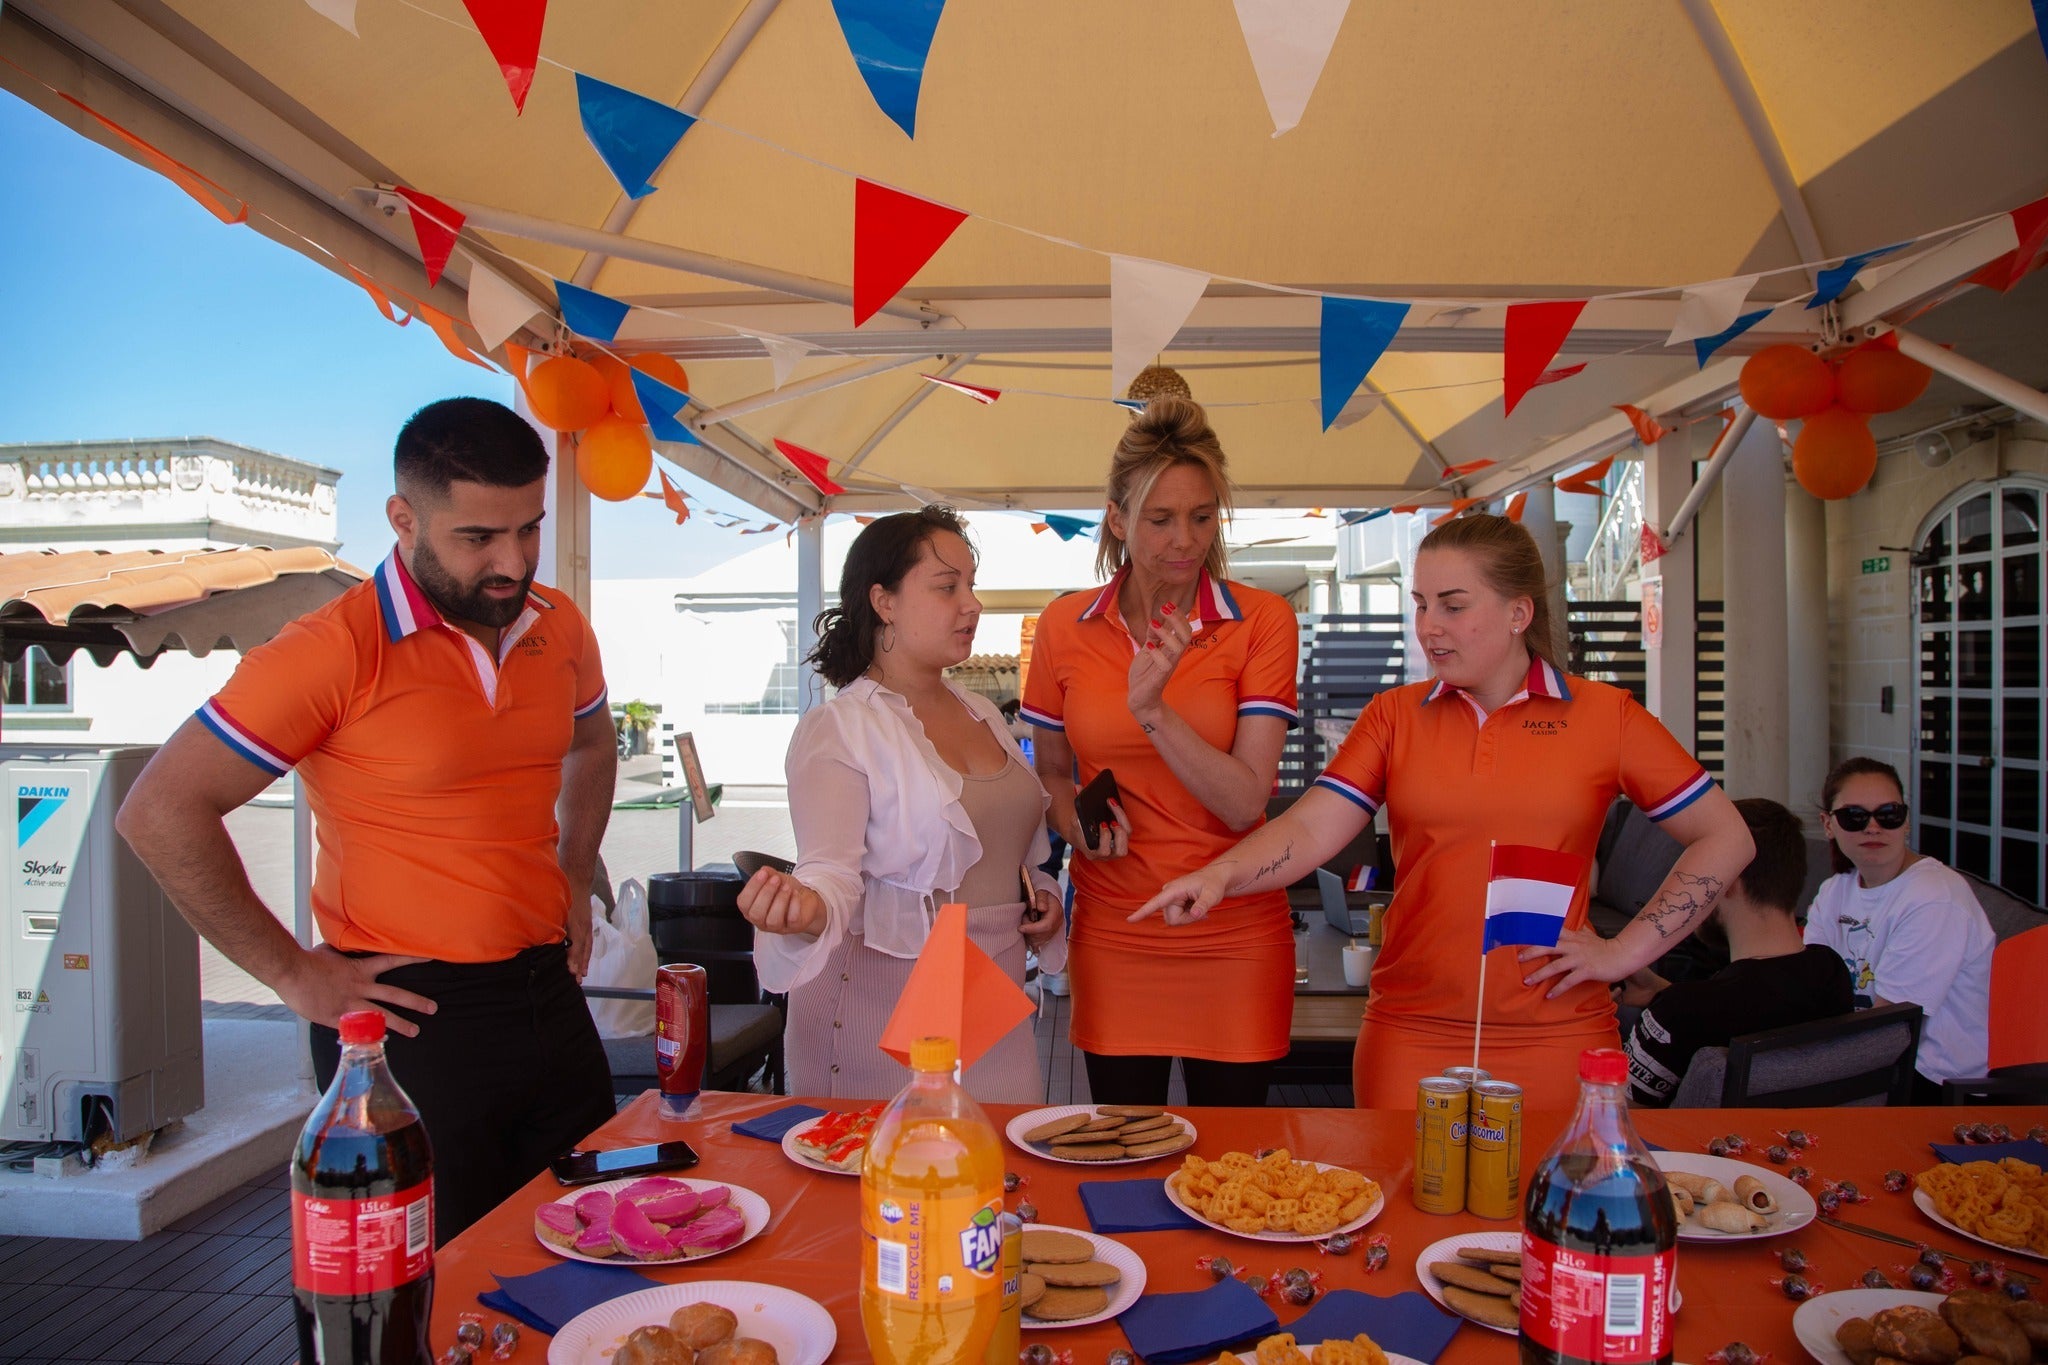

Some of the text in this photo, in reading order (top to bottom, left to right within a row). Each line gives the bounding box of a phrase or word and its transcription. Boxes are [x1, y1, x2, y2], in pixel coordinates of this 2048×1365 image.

[1522, 720, 1568, 729] JACK'S
[18, 786, 70, 798] DAIKIN
[22, 860, 67, 877] SkyAir
[17, 991, 32, 1000] R32
[960, 1212, 1004, 1267] FAN
[909, 1202, 920, 1300] RECYCLE ME
[1650, 1255, 1663, 1355] RECYCLE ME
